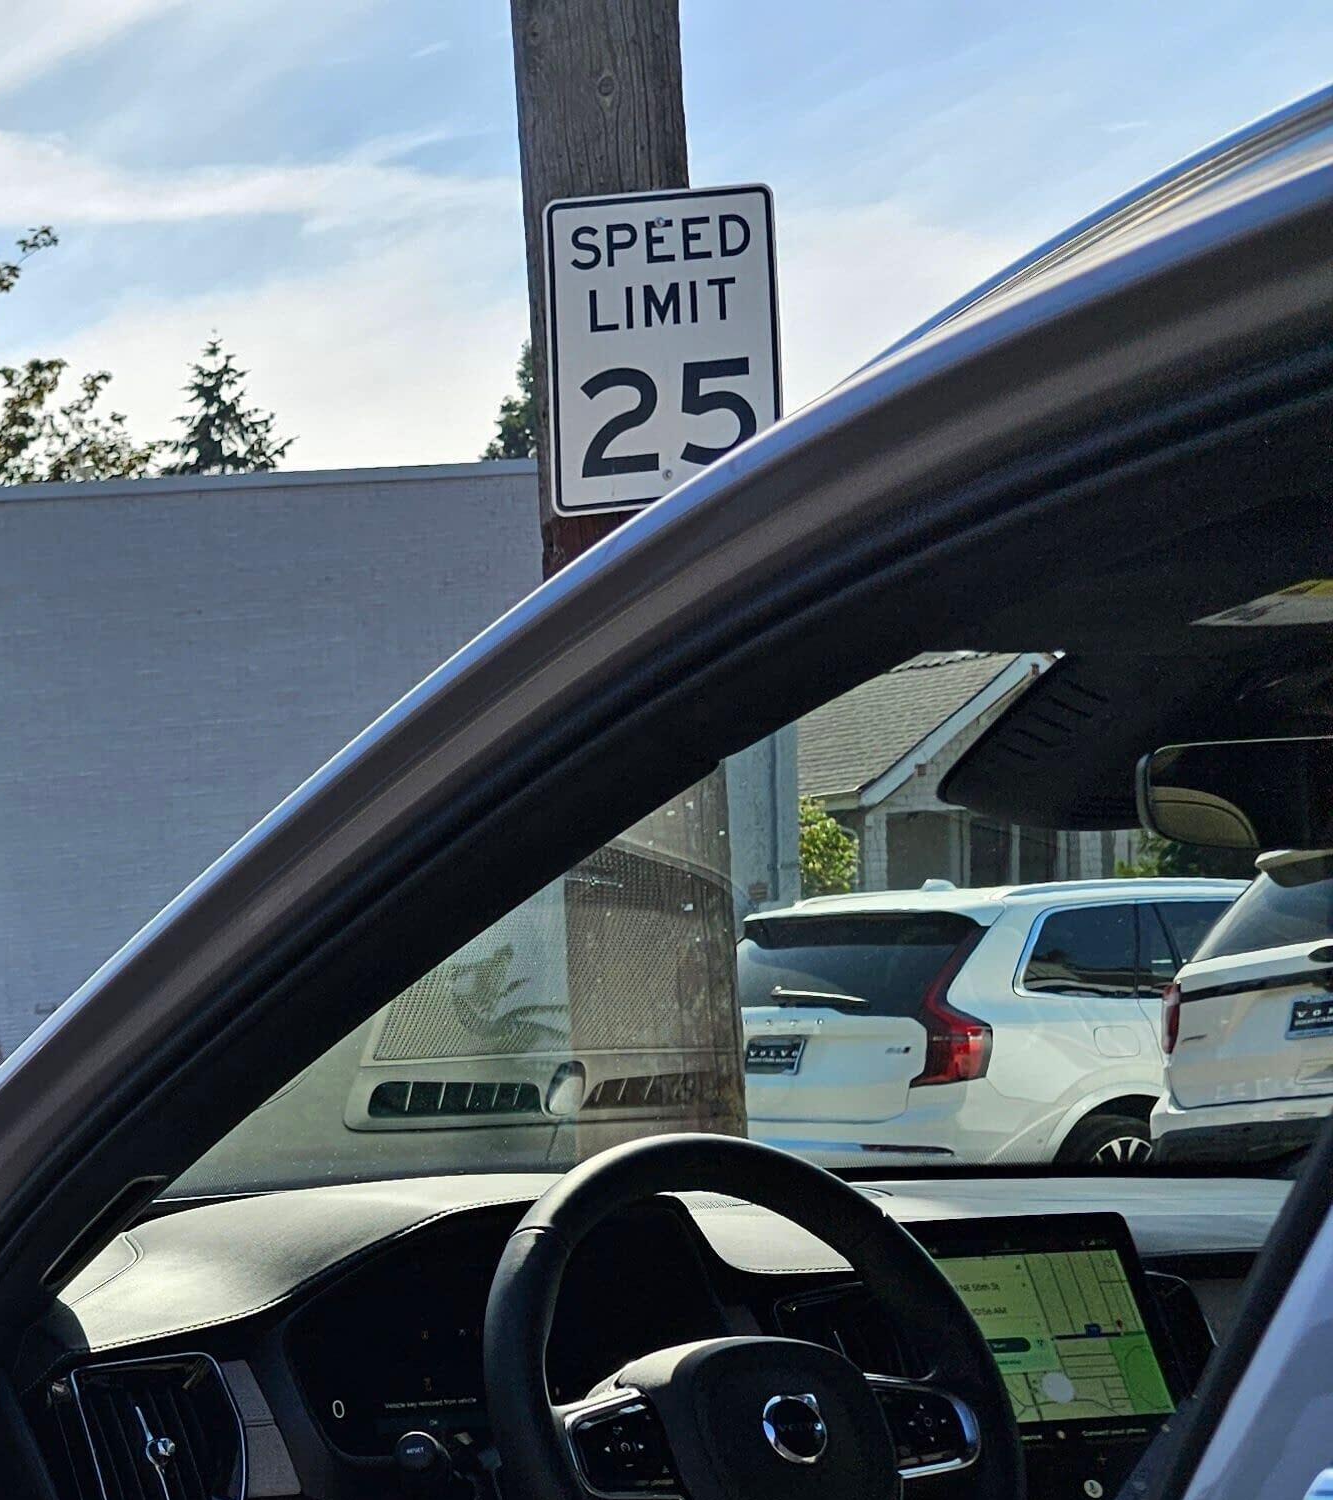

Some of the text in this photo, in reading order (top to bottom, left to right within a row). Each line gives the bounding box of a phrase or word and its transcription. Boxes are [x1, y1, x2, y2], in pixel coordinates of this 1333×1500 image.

[570, 213, 752, 271] SPEED
[588, 276, 736, 333] LIMIT
[580, 356, 758, 479] 25
[749, 1049, 799, 1058] VOLVO
[332, 1399, 345, 1419] 0
